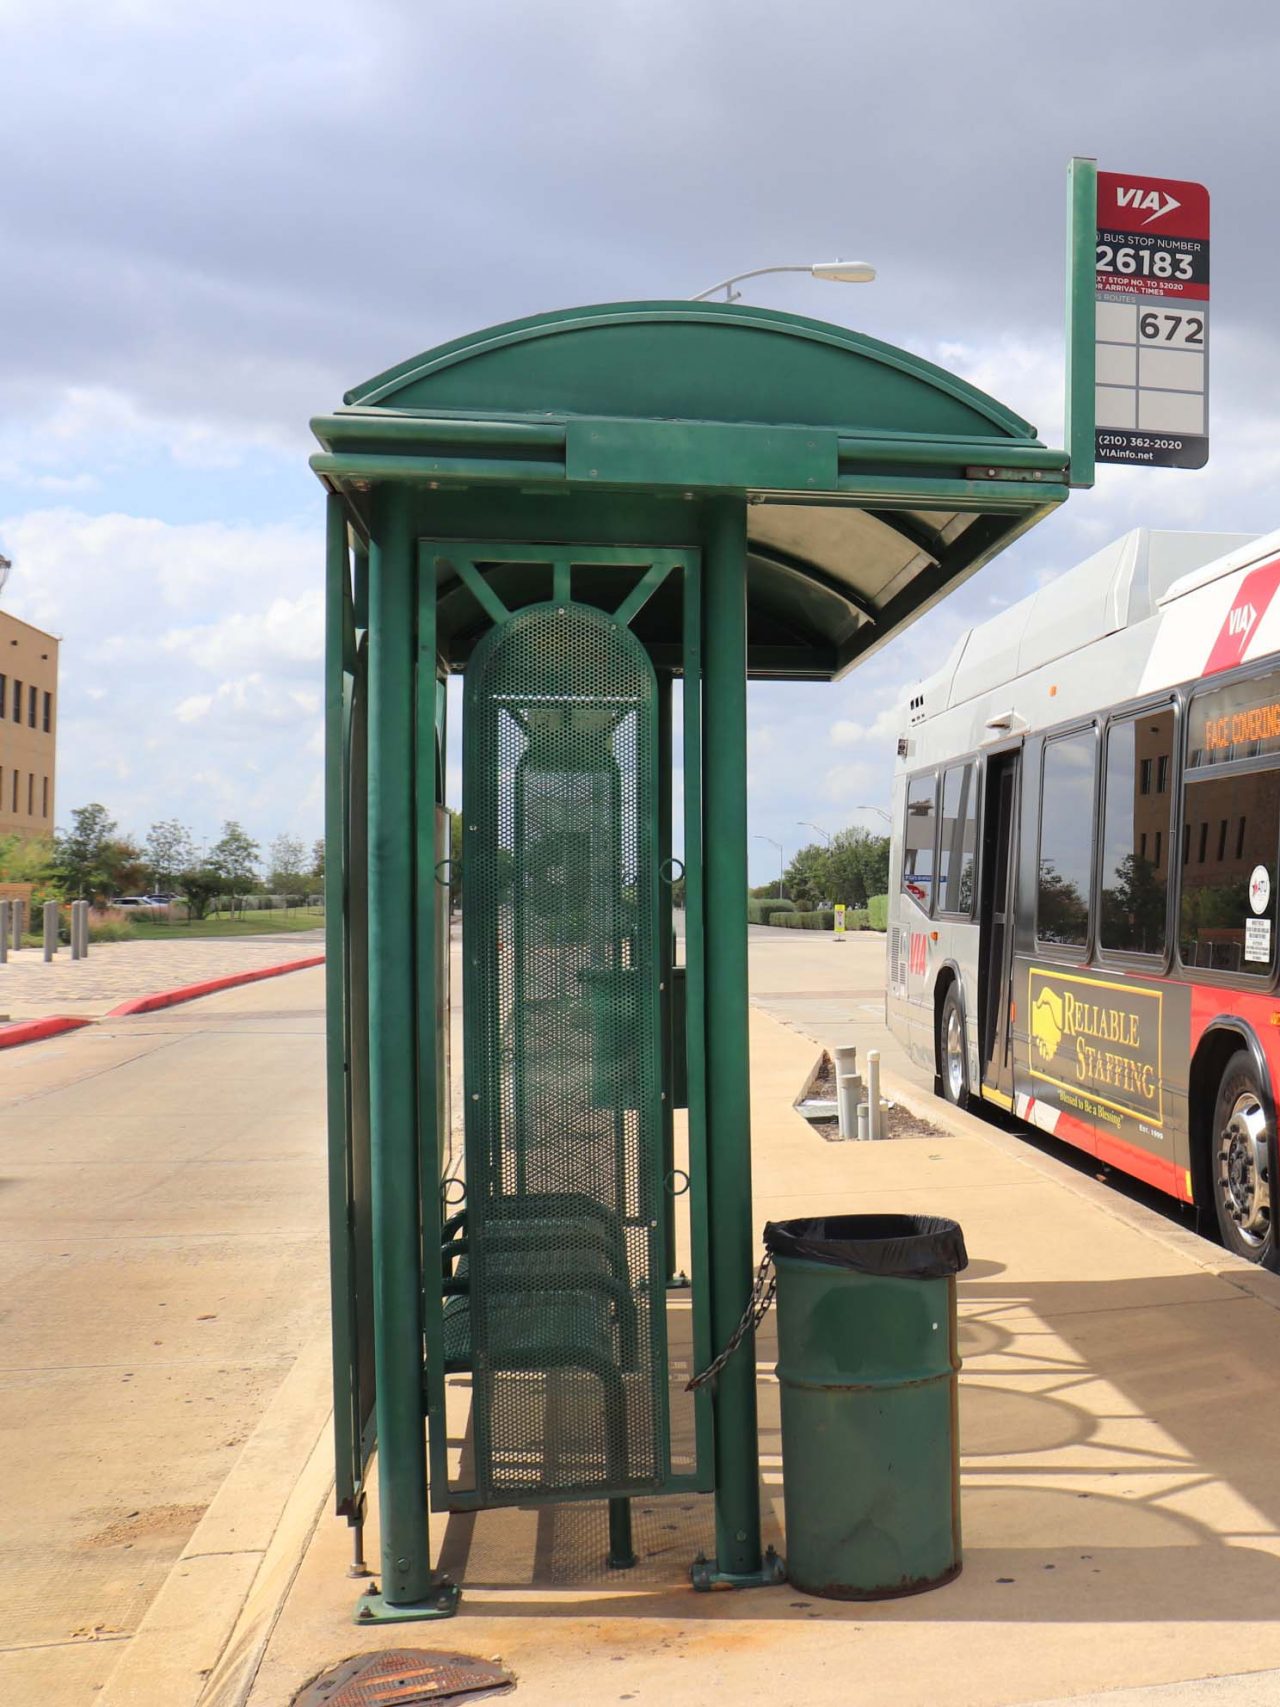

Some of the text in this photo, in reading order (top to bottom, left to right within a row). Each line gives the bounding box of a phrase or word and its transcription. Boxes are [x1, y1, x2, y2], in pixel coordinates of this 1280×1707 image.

[1116, 187, 1160, 211] VIA
[1103, 233, 1201, 251] BUS STOP NUMBER
[1096, 245, 1194, 280] 26183
[1105, 284, 1139, 294] ARRIVAL
[1140, 287, 1164, 296] TIMES
[1108, 276, 1129, 285] STOP
[1130, 279, 1145, 287] NO.
[1103, 293, 1137, 303] ROUTES
[1140, 313, 1204, 344] 672
[1098, 435, 1183, 450] (210) 362-2020
[1099, 448, 1154, 461] VIAinfo.net
[1228, 603, 1251, 637] VIA
[1205, 716, 1230, 751] FACE
[910, 932, 927, 976] VIA
[1063, 992, 1140, 1049] RELIABLE
[1075, 1036, 1156, 1098] STAFFING
[1084, 1099, 1092, 1114] Be
